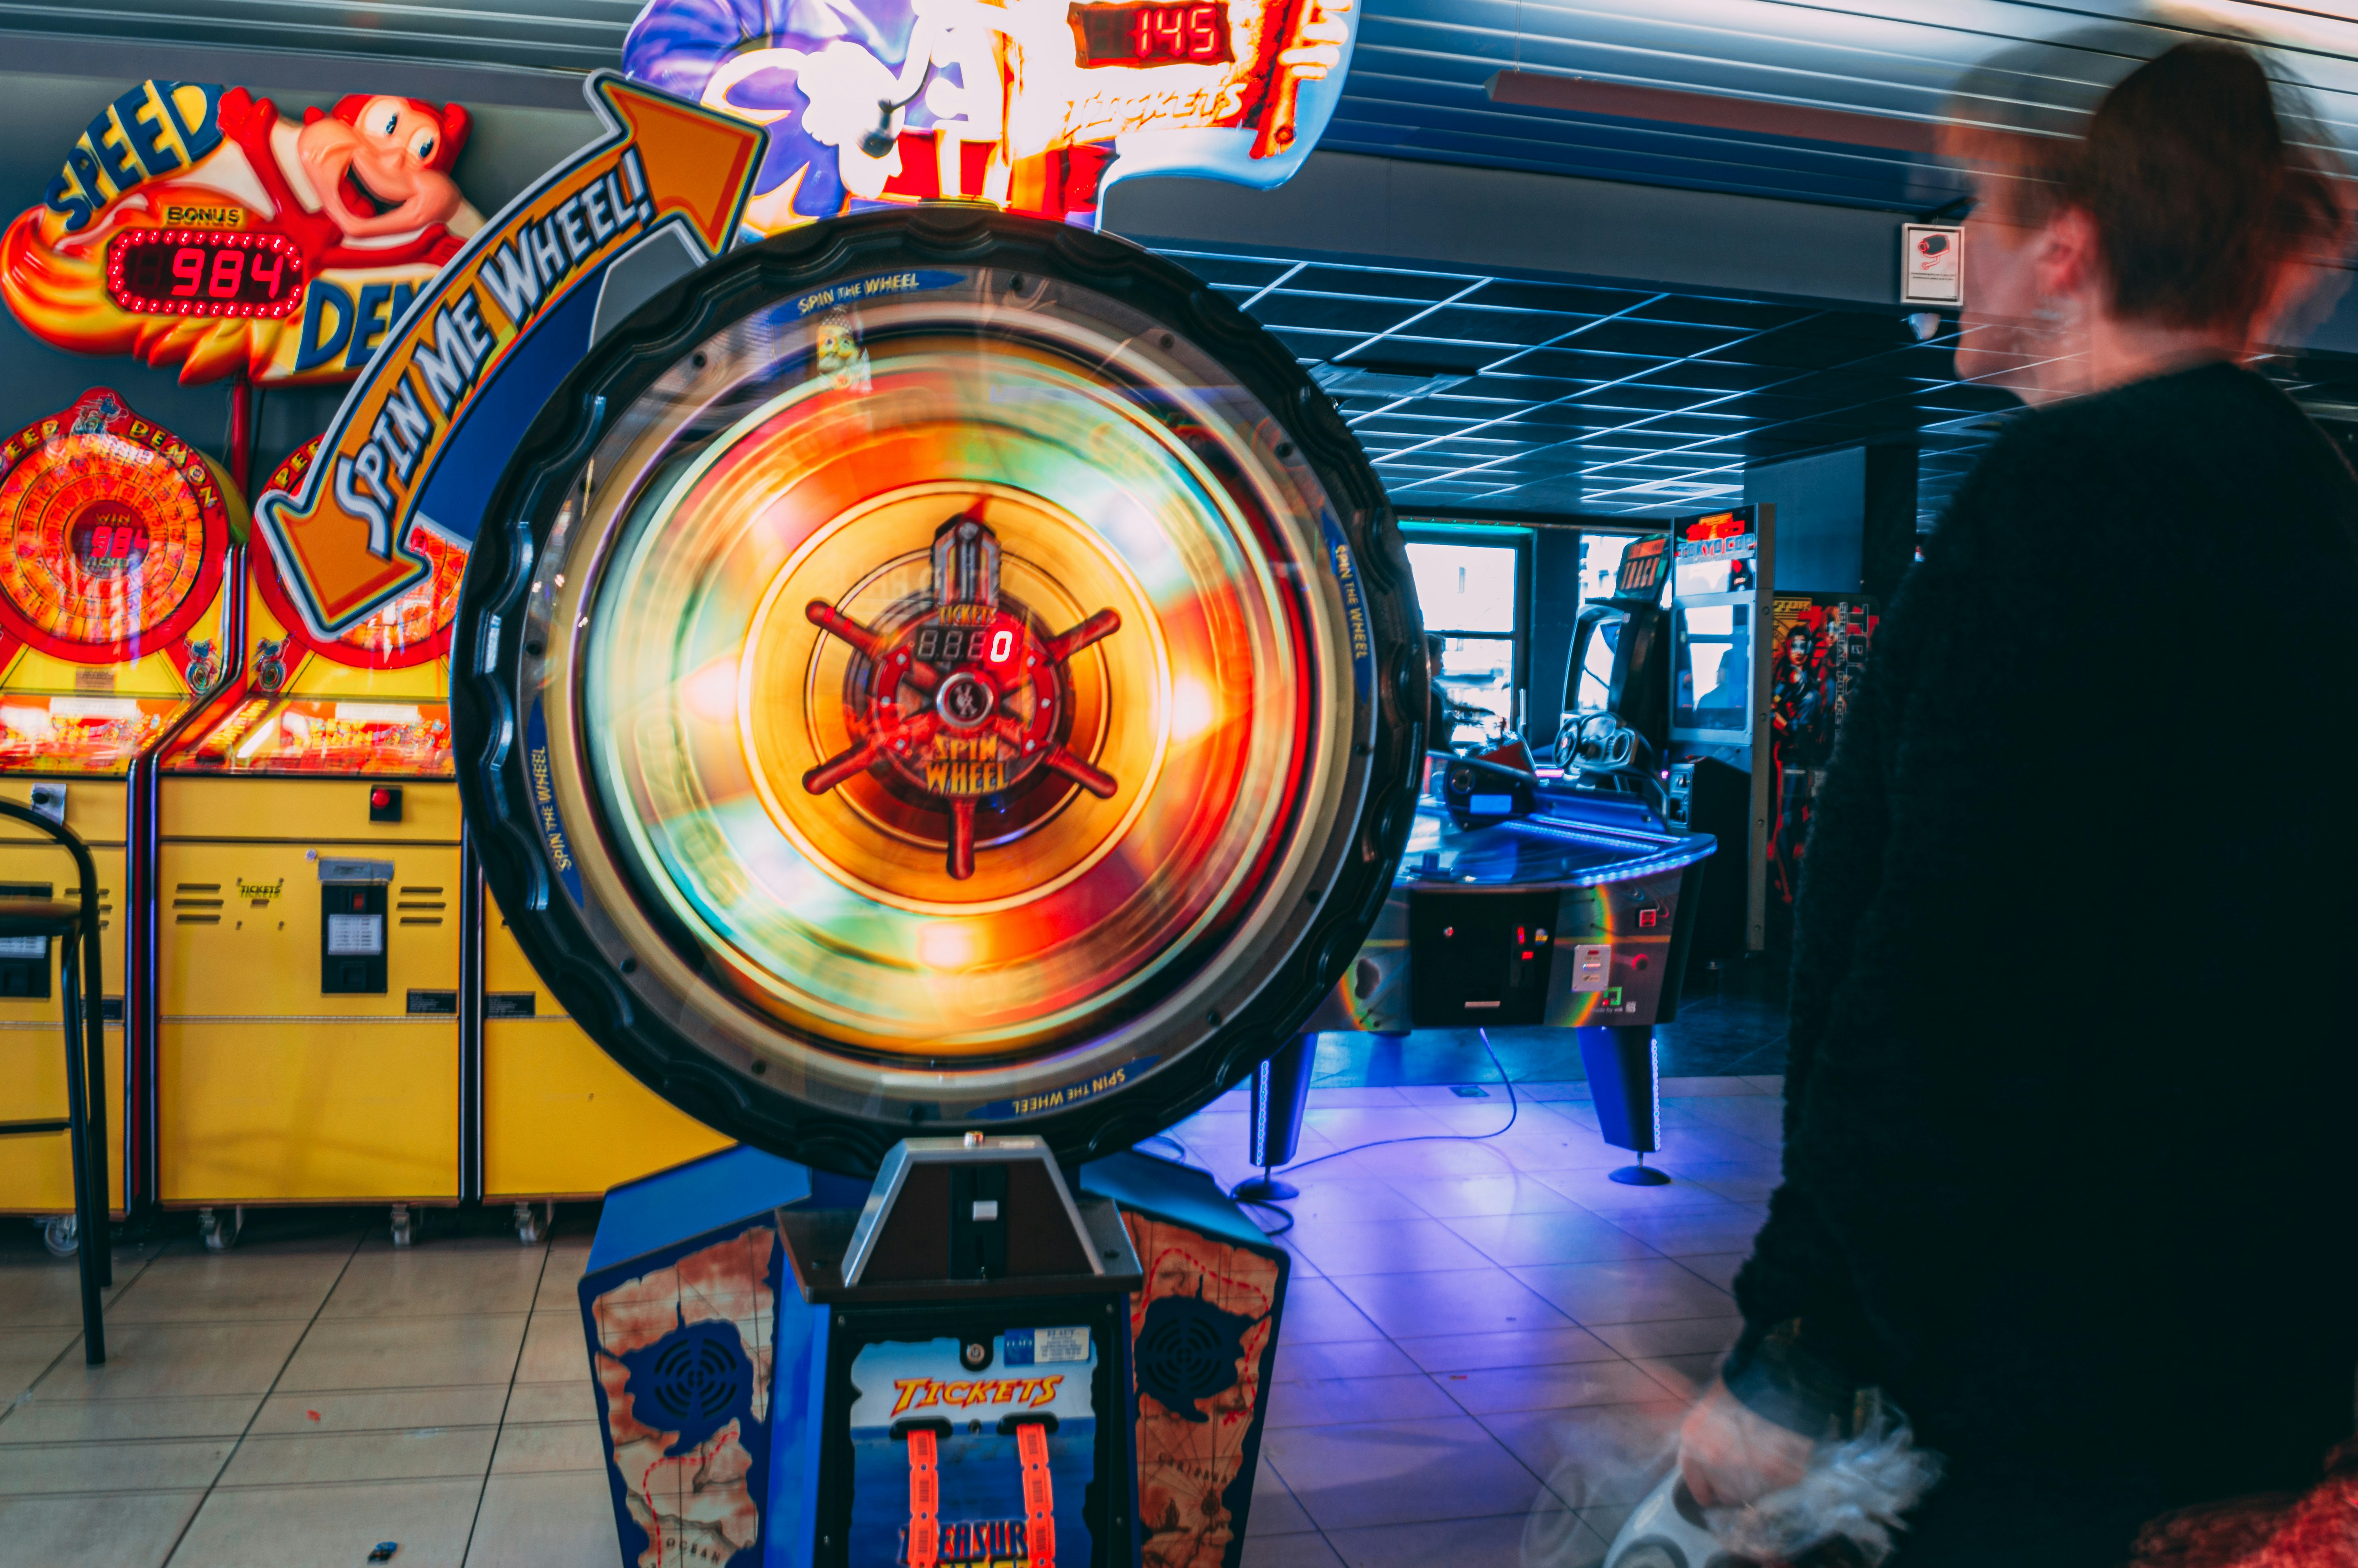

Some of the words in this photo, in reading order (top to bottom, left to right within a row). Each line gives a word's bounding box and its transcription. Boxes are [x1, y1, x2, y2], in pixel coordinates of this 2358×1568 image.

[1137, 7, 1216, 56] 145
[44, 80, 226, 231] SPEED
[167, 206, 240, 226] BONUS
[172, 248, 284, 298] 984
[798, 290, 834, 314] SPIN
[838, 282, 862, 298] THE
[864, 273, 919, 294] WHEEL
[335, 376, 436, 561] SPIN
[414, 291, 498, 416] ME
[478, 145, 657, 324] WHEEL!
[129, 419, 218, 508] DEMON
[95, 512, 131, 526] WIN
[1335, 544, 1354, 580] SPIN
[1676, 538, 1722, 558] TOKYO
[1725, 533, 1755, 552] COP
[1345, 581, 1359, 606] THE
[939, 605, 997, 626] TICKETS
[1349, 607, 1368, 659] WHEEL
[933, 733, 998, 762] SPIN
[531, 746, 552, 804] WHEEL
[926, 762, 1009, 796] WHEEL
[541, 804, 557, 833] THE
[549, 833, 572, 872] SPIN
[241, 886, 281, 895] TICKETS
[1067, 1083, 1090, 1101] THE
[1092, 1068, 1126, 1093] SPIN
[1012, 1090, 1064, 1115] WHEEL
[890, 1375, 1065, 1419] TICKETS
[666, 1537, 721, 1565] OCEAN
[899, 1519, 1029, 1562] TEASUR
